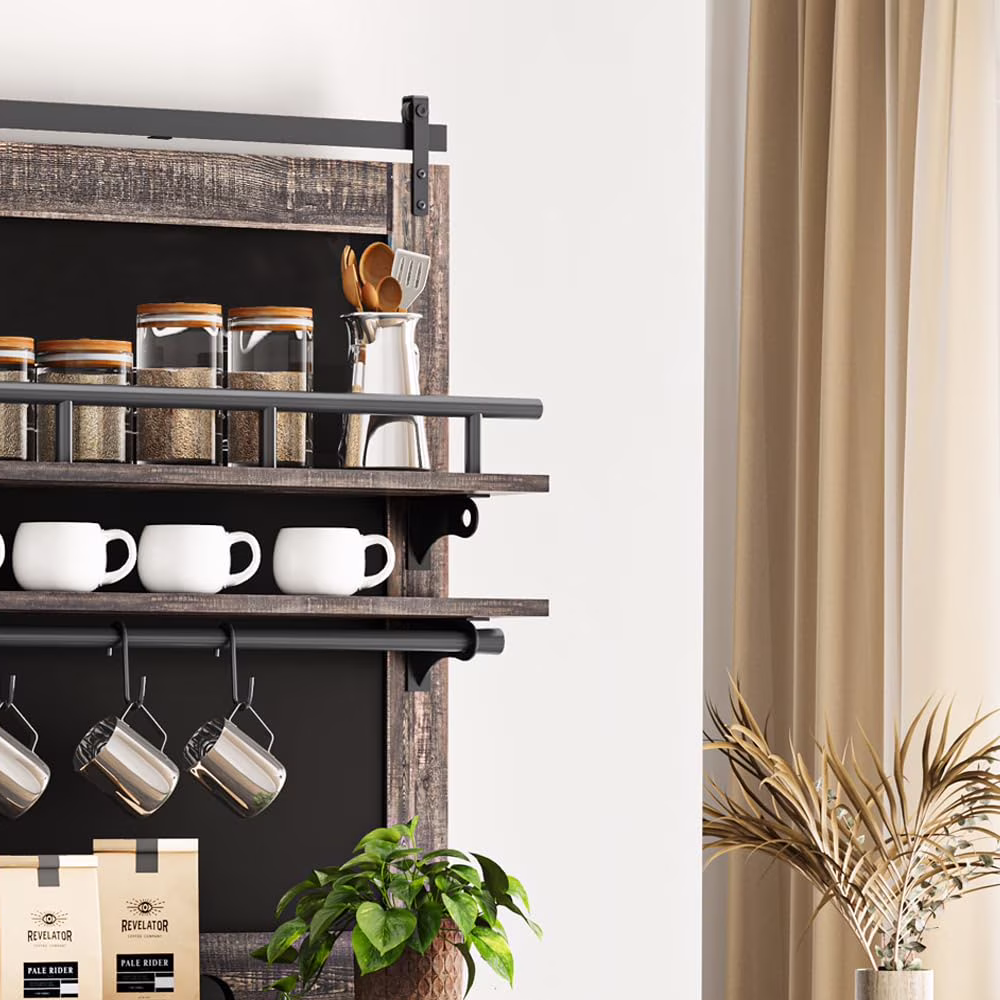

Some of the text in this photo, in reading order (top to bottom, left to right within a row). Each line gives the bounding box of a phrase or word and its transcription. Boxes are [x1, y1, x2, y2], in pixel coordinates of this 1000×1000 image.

[121, 919, 169, 933] REVELATOR
[27, 929, 73, 943] REVELATOR
[120, 958, 169, 967] PALE RIDER
[27, 966, 74, 975] PALE RIDER
